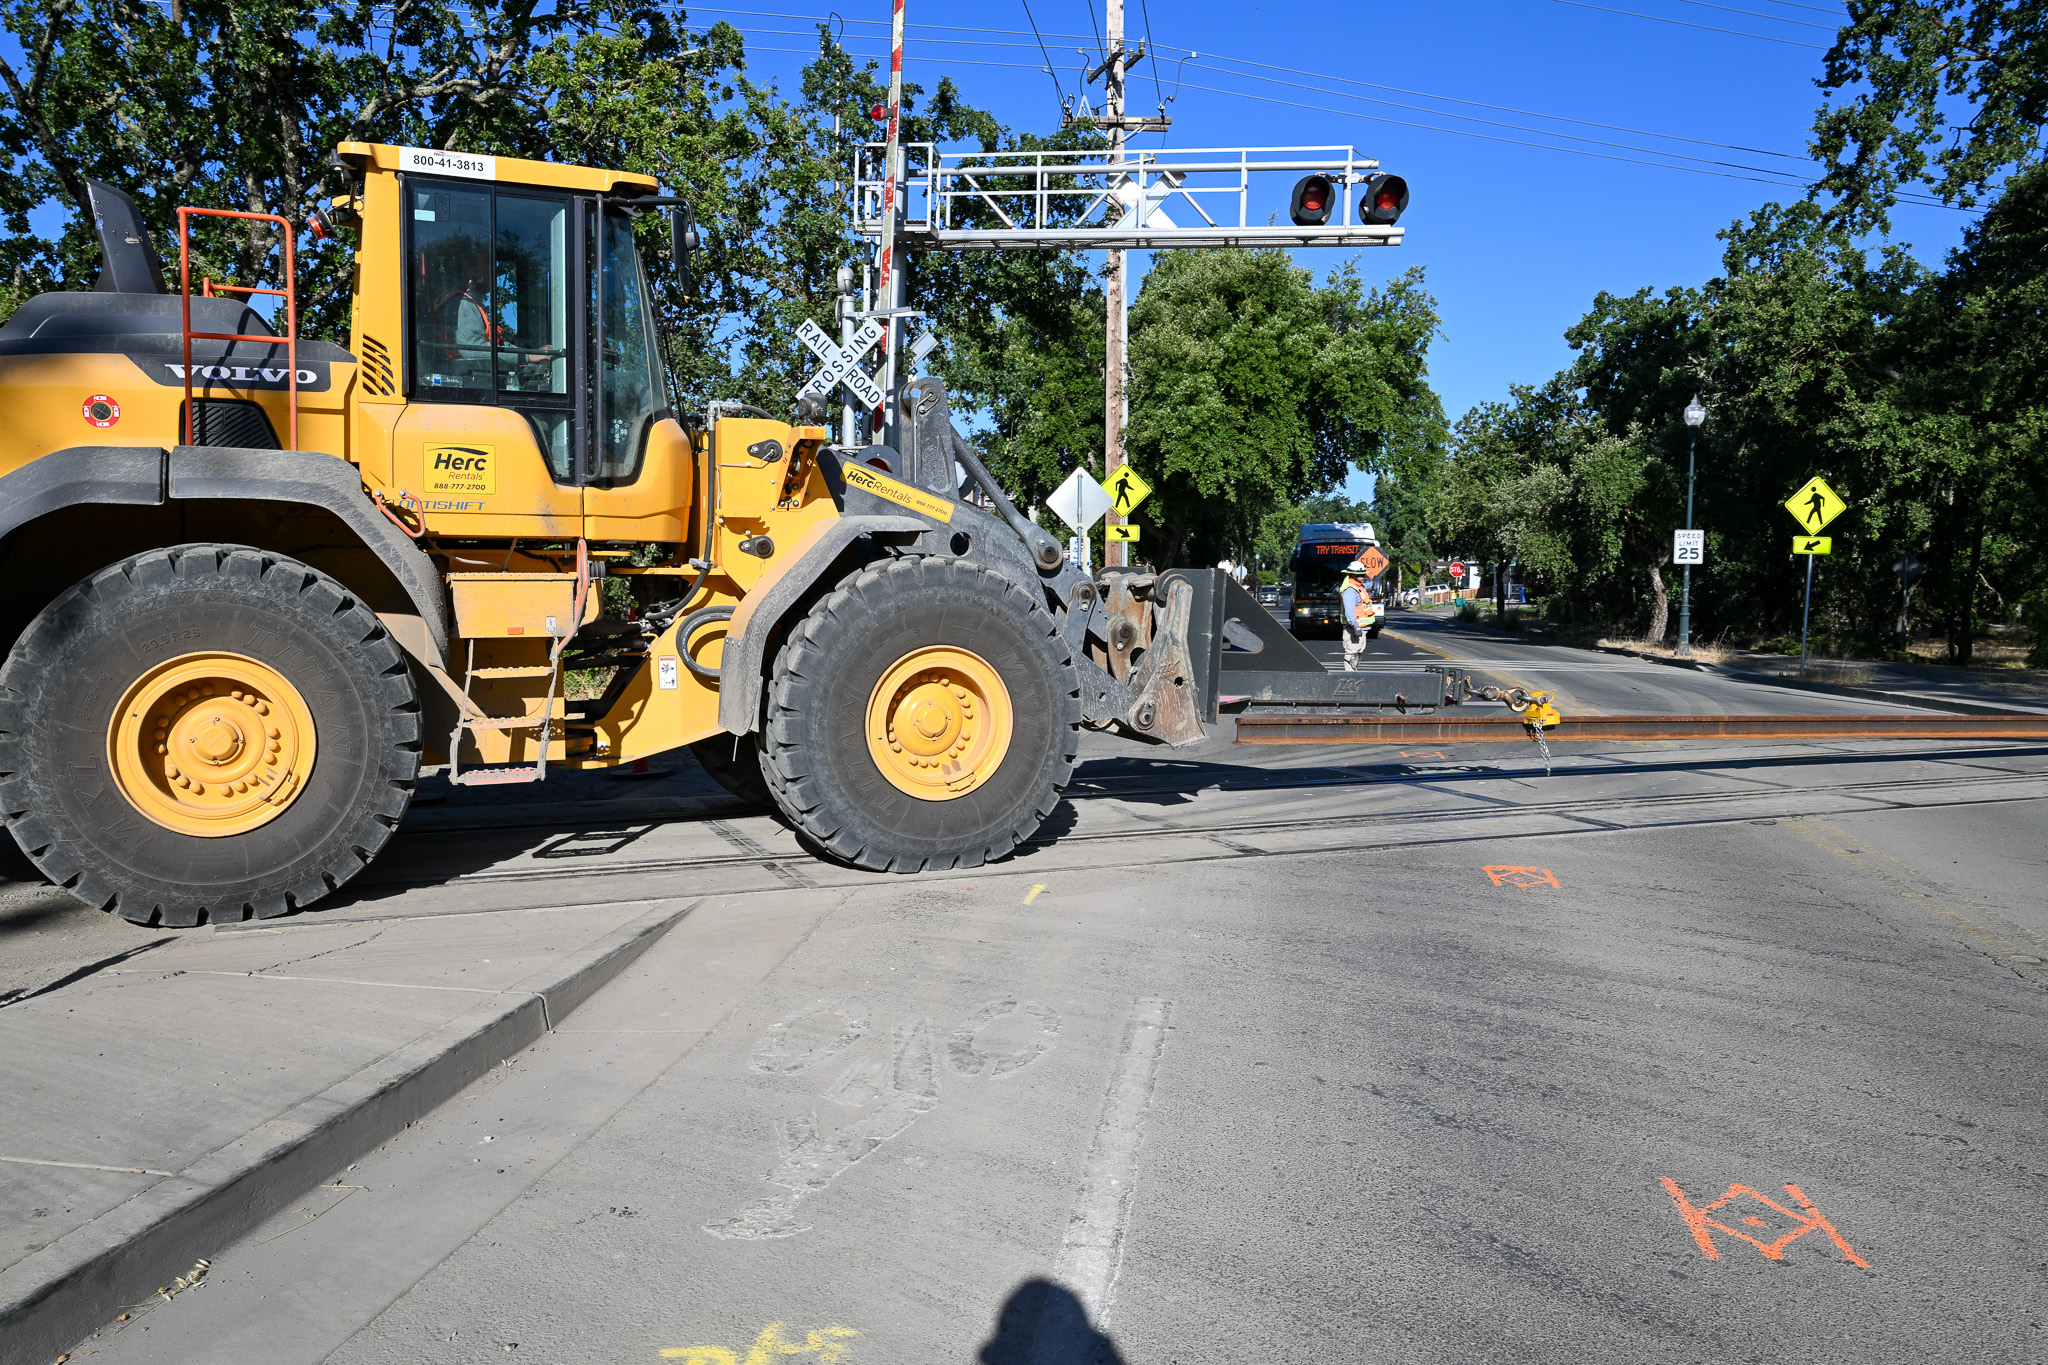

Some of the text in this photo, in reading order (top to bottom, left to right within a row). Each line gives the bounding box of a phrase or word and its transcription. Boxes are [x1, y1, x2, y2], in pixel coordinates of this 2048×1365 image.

[413, 154, 484, 172] 800-41-3813
[800, 322, 831, 358] RAIL
[804, 326, 877, 395] ROSSING
[165, 363, 318, 384] VOLVO
[845, 368, 881, 404] ROAD
[434, 453, 487, 471] Herc
[448, 471, 484, 481] Rentals
[434, 483, 486, 491] 888-777-2700
[1316, 545, 1360, 555] TRY TRANSIT
[1678, 547, 1699, 559] 25
[1361, 557, 1384, 569] SLOW
